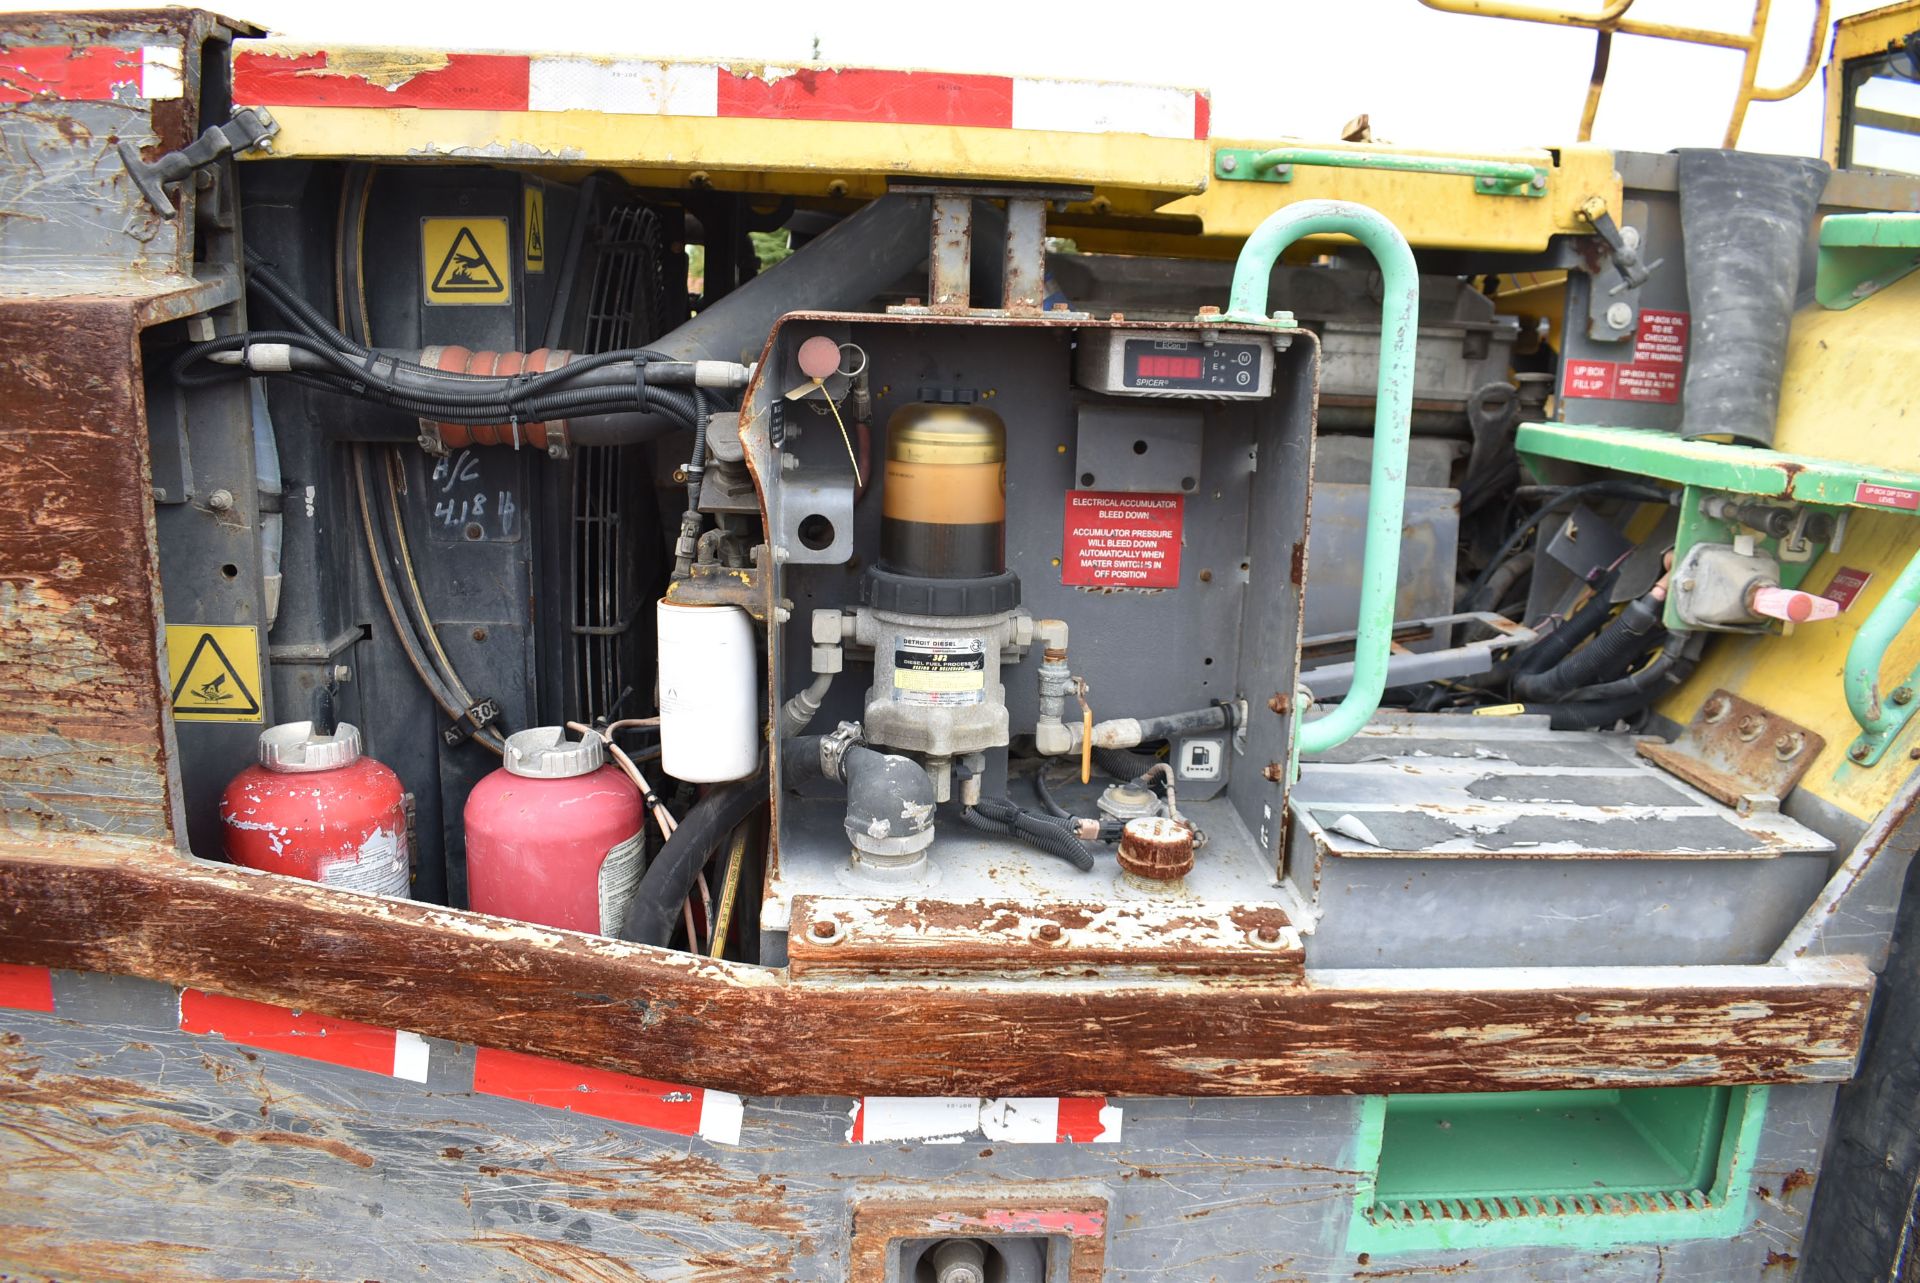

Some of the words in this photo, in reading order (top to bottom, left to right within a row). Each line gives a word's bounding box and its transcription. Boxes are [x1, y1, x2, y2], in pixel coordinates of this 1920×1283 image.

[432, 449, 480, 493] A/C
[1072, 498, 1119, 507] ELECTRICAL
[1120, 499, 1177, 509] ACCUMULATOR
[1099, 510, 1124, 519] BLEED
[1125, 511, 1149, 519] DOWN
[1072, 528, 1131, 537] ACCUMULATOR
[1131, 529, 1173, 538] PRESSURE
[1087, 539, 1106, 547] WILL
[1107, 539, 1132, 547] BLEED
[1133, 540, 1157, 548] DOWN
[1079, 549, 1140, 558] AUTOMATICALLY
[1141, 550, 1165, 559] WHEN
[1080, 559, 1113, 568] MASTER
[1153, 561, 1162, 569] IN
[1094, 570, 1110, 578] OFF
[1111, 570, 1147, 579] POSITION
[903, 638, 930, 646] DETROIT
